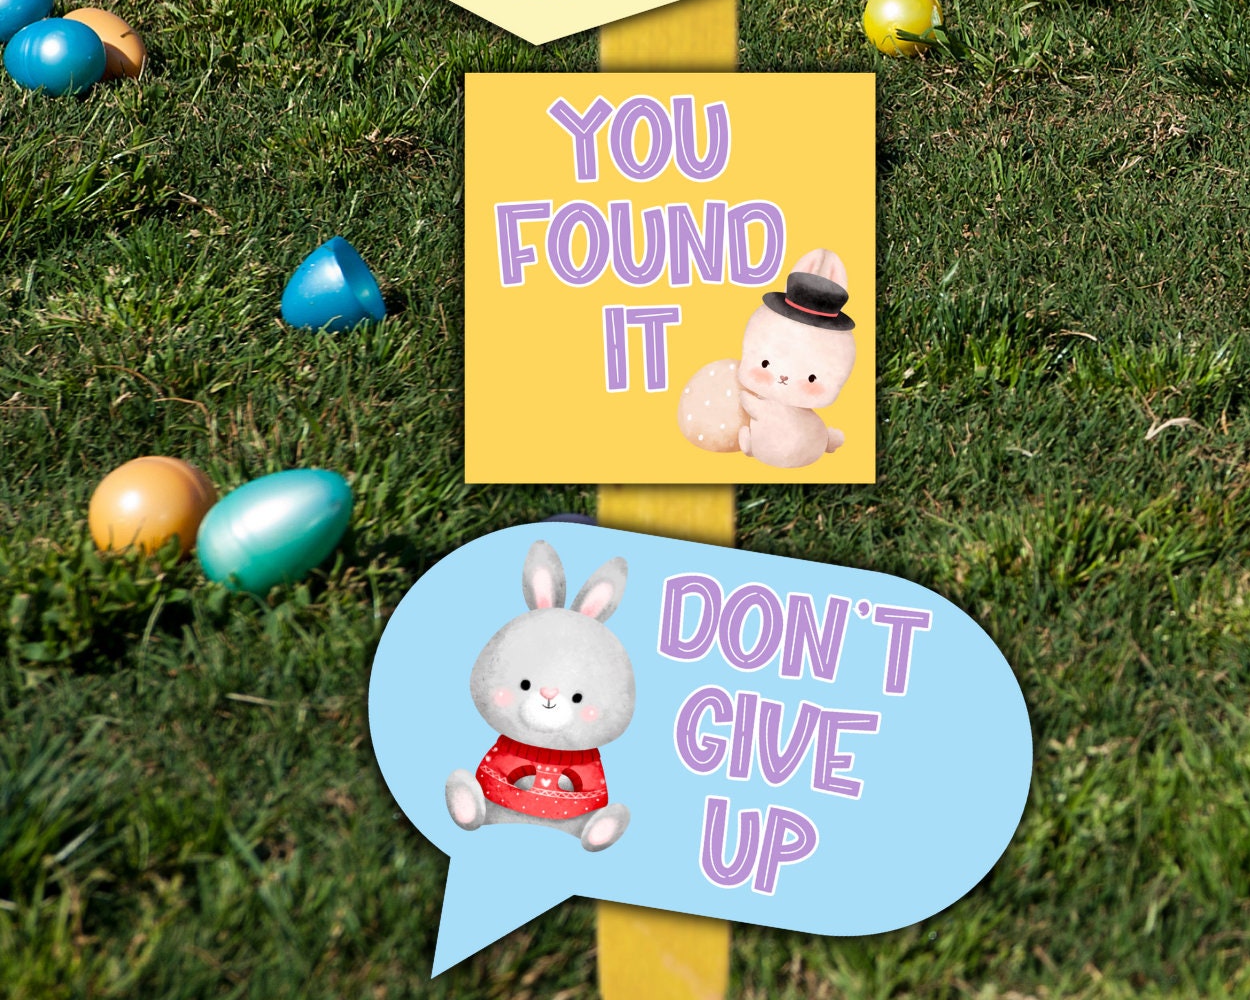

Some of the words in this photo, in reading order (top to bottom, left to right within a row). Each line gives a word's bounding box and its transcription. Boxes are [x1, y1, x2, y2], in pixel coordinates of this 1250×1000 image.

[548, 96, 730, 181] YOU
[496, 201, 785, 286] FOUND
[604, 306, 680, 391] IT
[659, 574, 931, 695] DON'T
[675, 686, 880, 798] GIVE
[701, 797, 818, 894] UP
